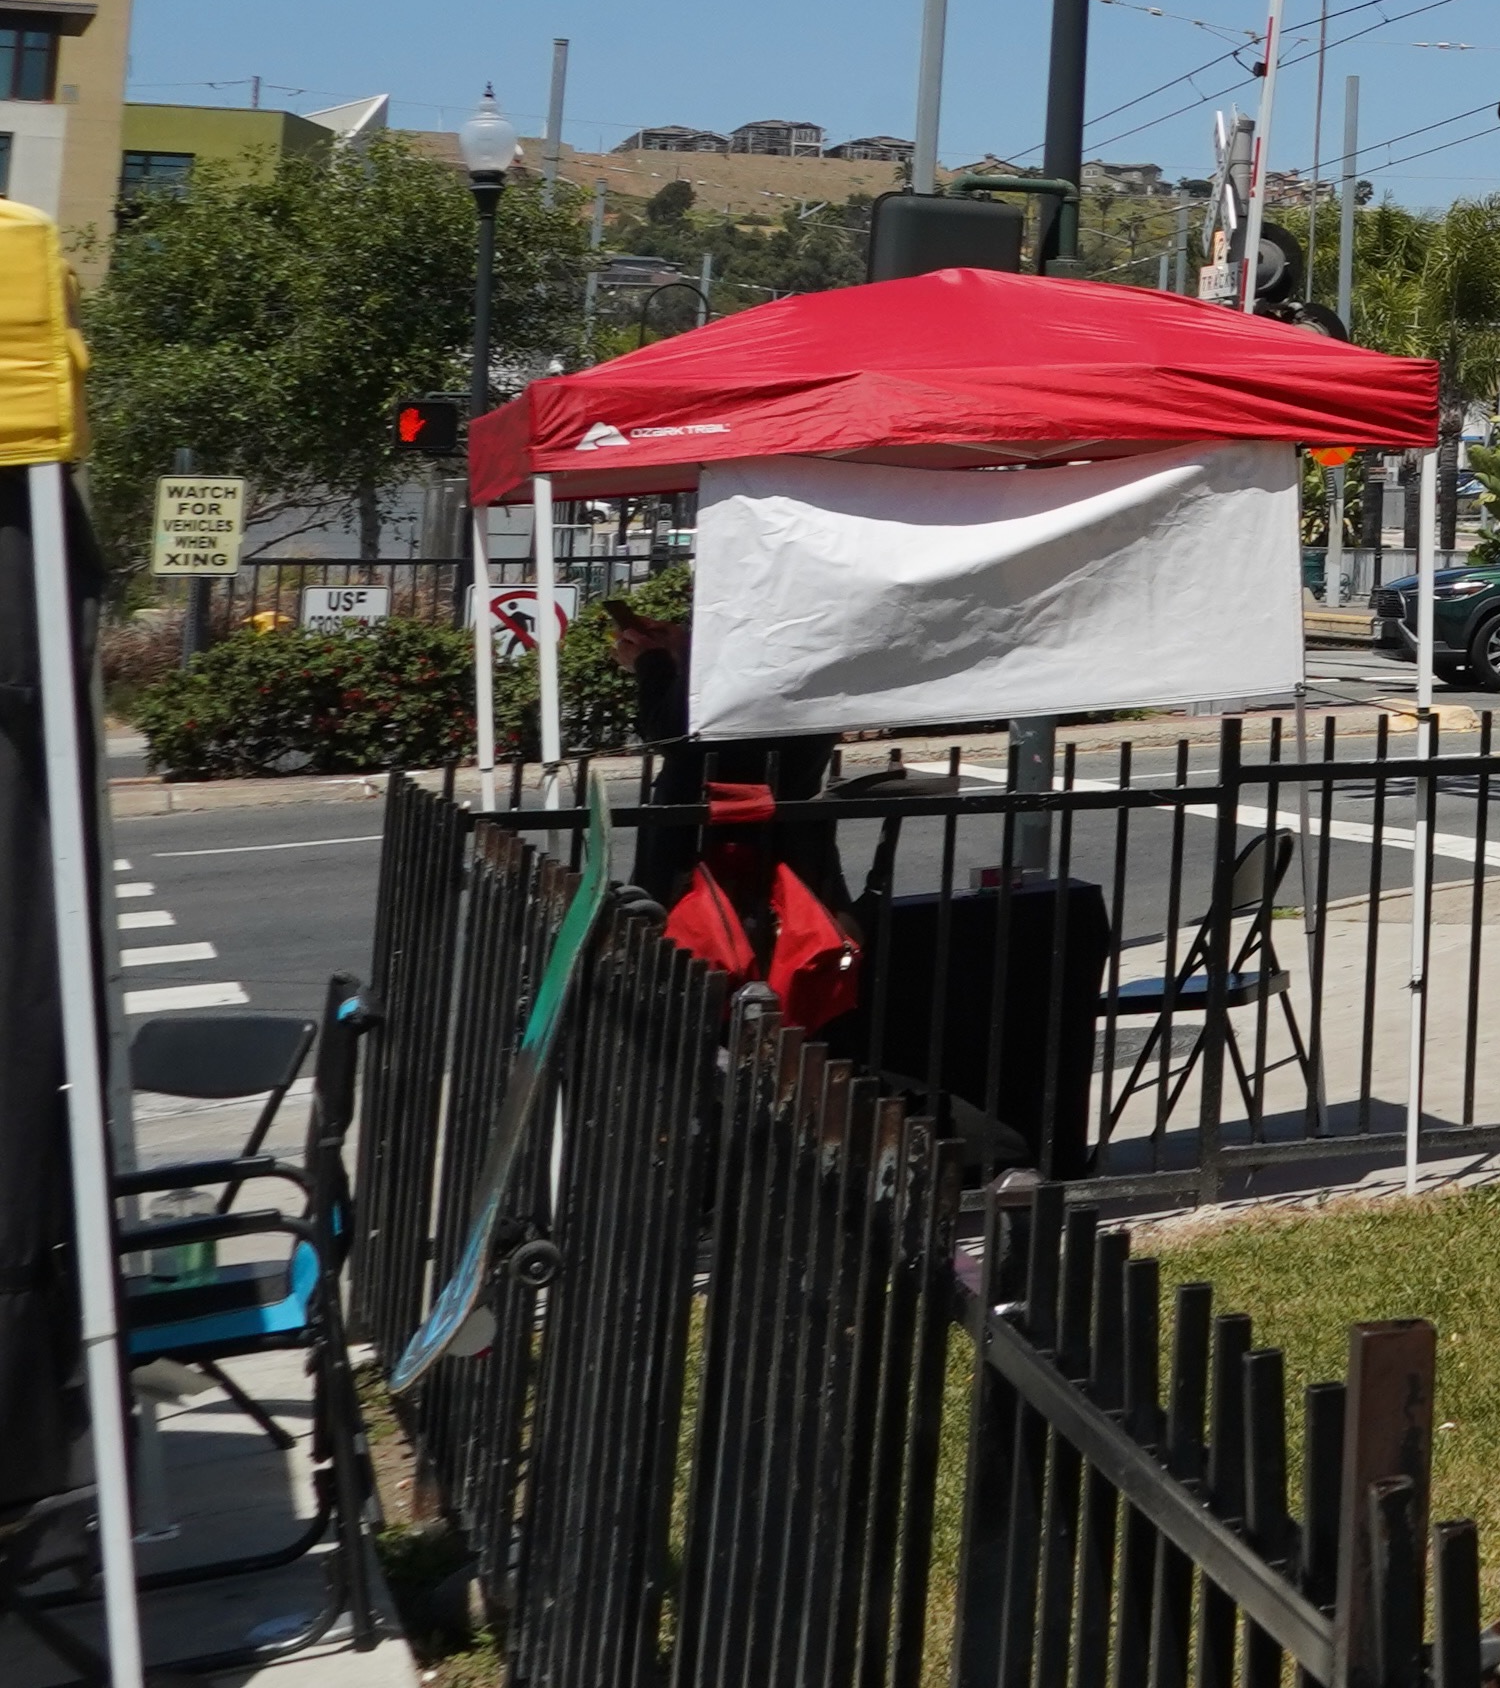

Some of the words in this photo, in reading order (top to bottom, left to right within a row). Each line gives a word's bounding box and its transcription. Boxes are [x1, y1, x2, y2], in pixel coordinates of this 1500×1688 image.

[167, 485, 238, 500] WATCH
[177, 502, 222, 516] FOR
[163, 519, 234, 533] VEHICLES
[174, 535, 218, 550] WHEN
[164, 553, 228, 567] XING
